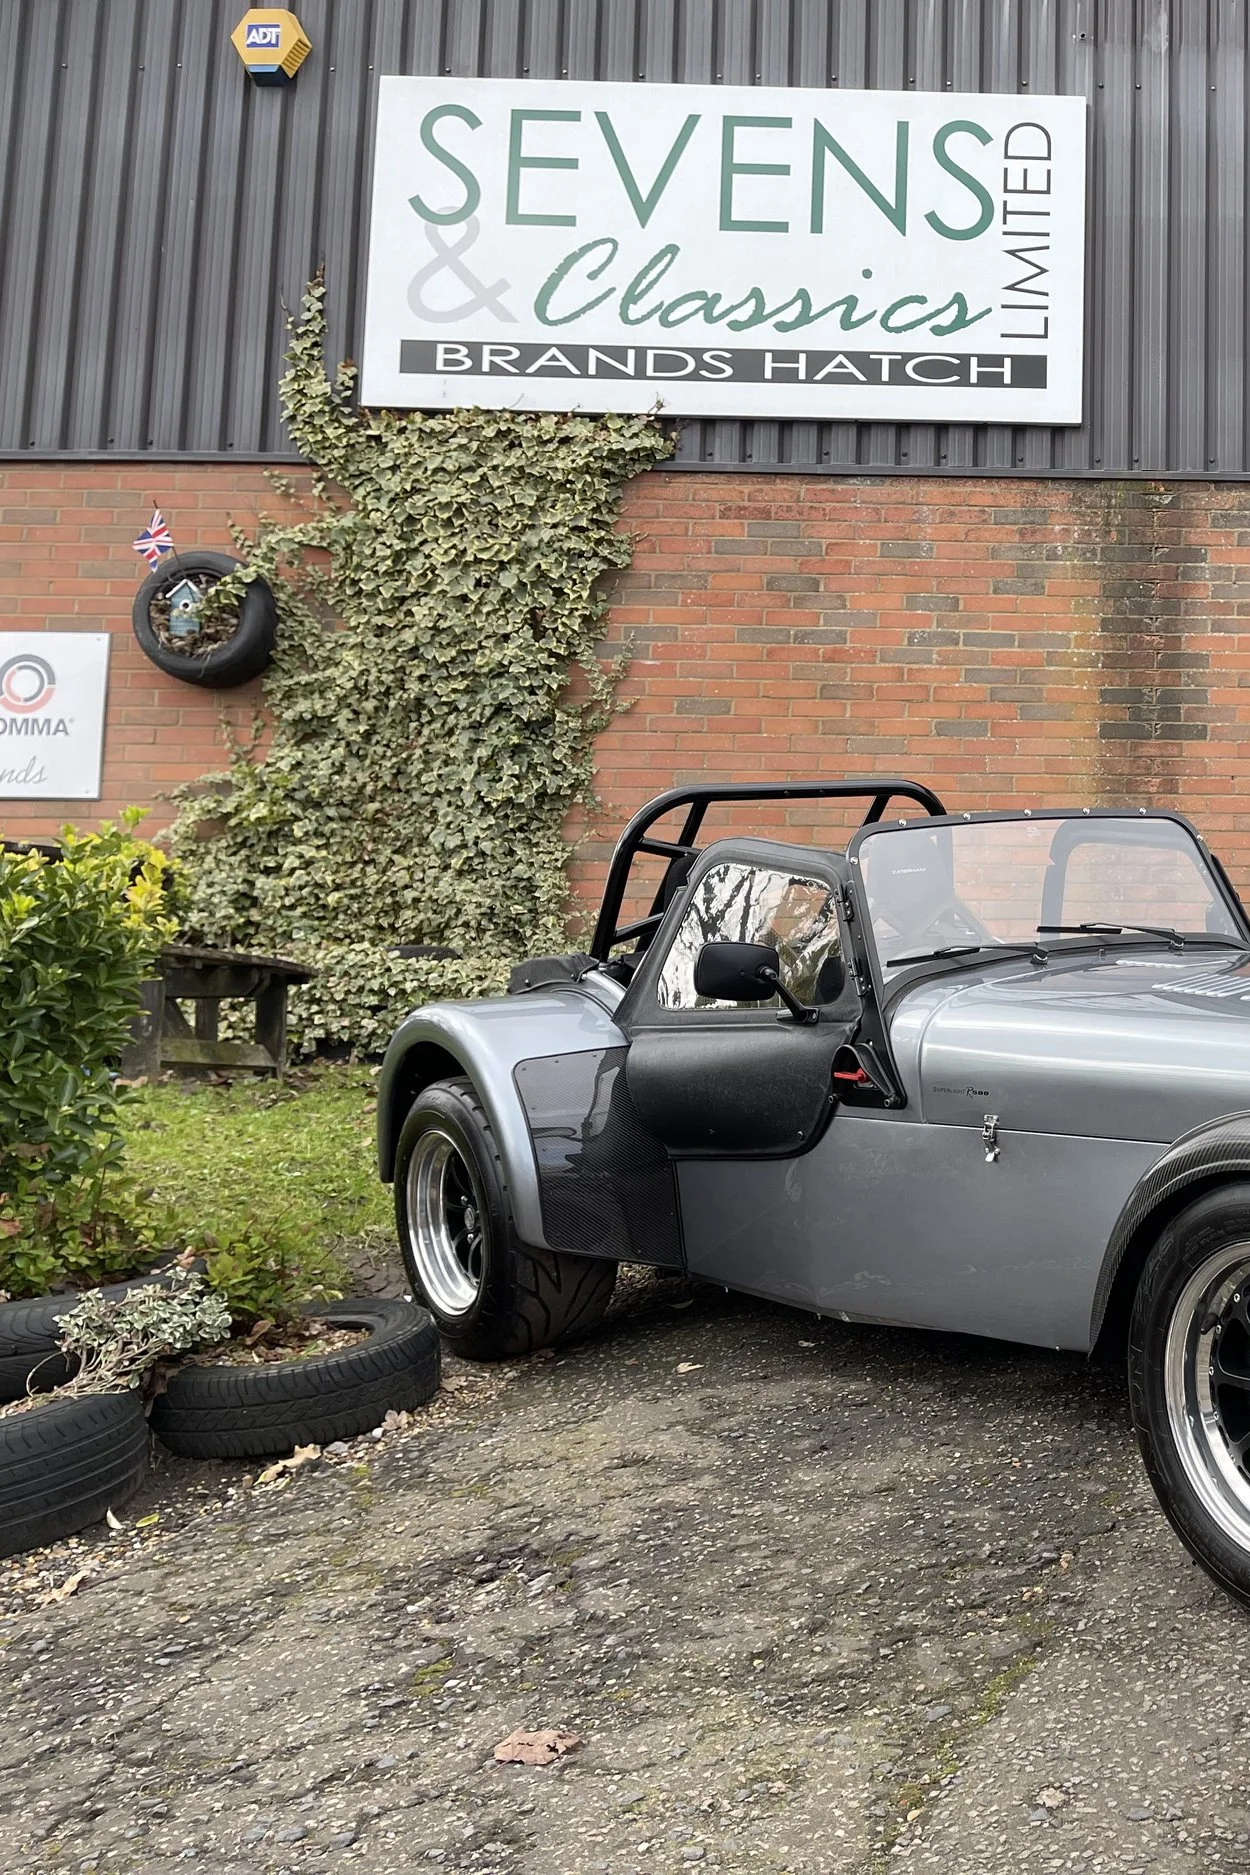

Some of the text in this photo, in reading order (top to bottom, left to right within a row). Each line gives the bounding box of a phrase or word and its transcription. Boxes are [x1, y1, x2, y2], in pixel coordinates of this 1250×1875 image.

[246, 27, 281, 45] ADT
[408, 104, 995, 241] SEVENS
[1001, 121, 1052, 339] LIMITED
[406, 205, 992, 337] & Classics
[436, 344, 1012, 384] BRANDS HATCH
